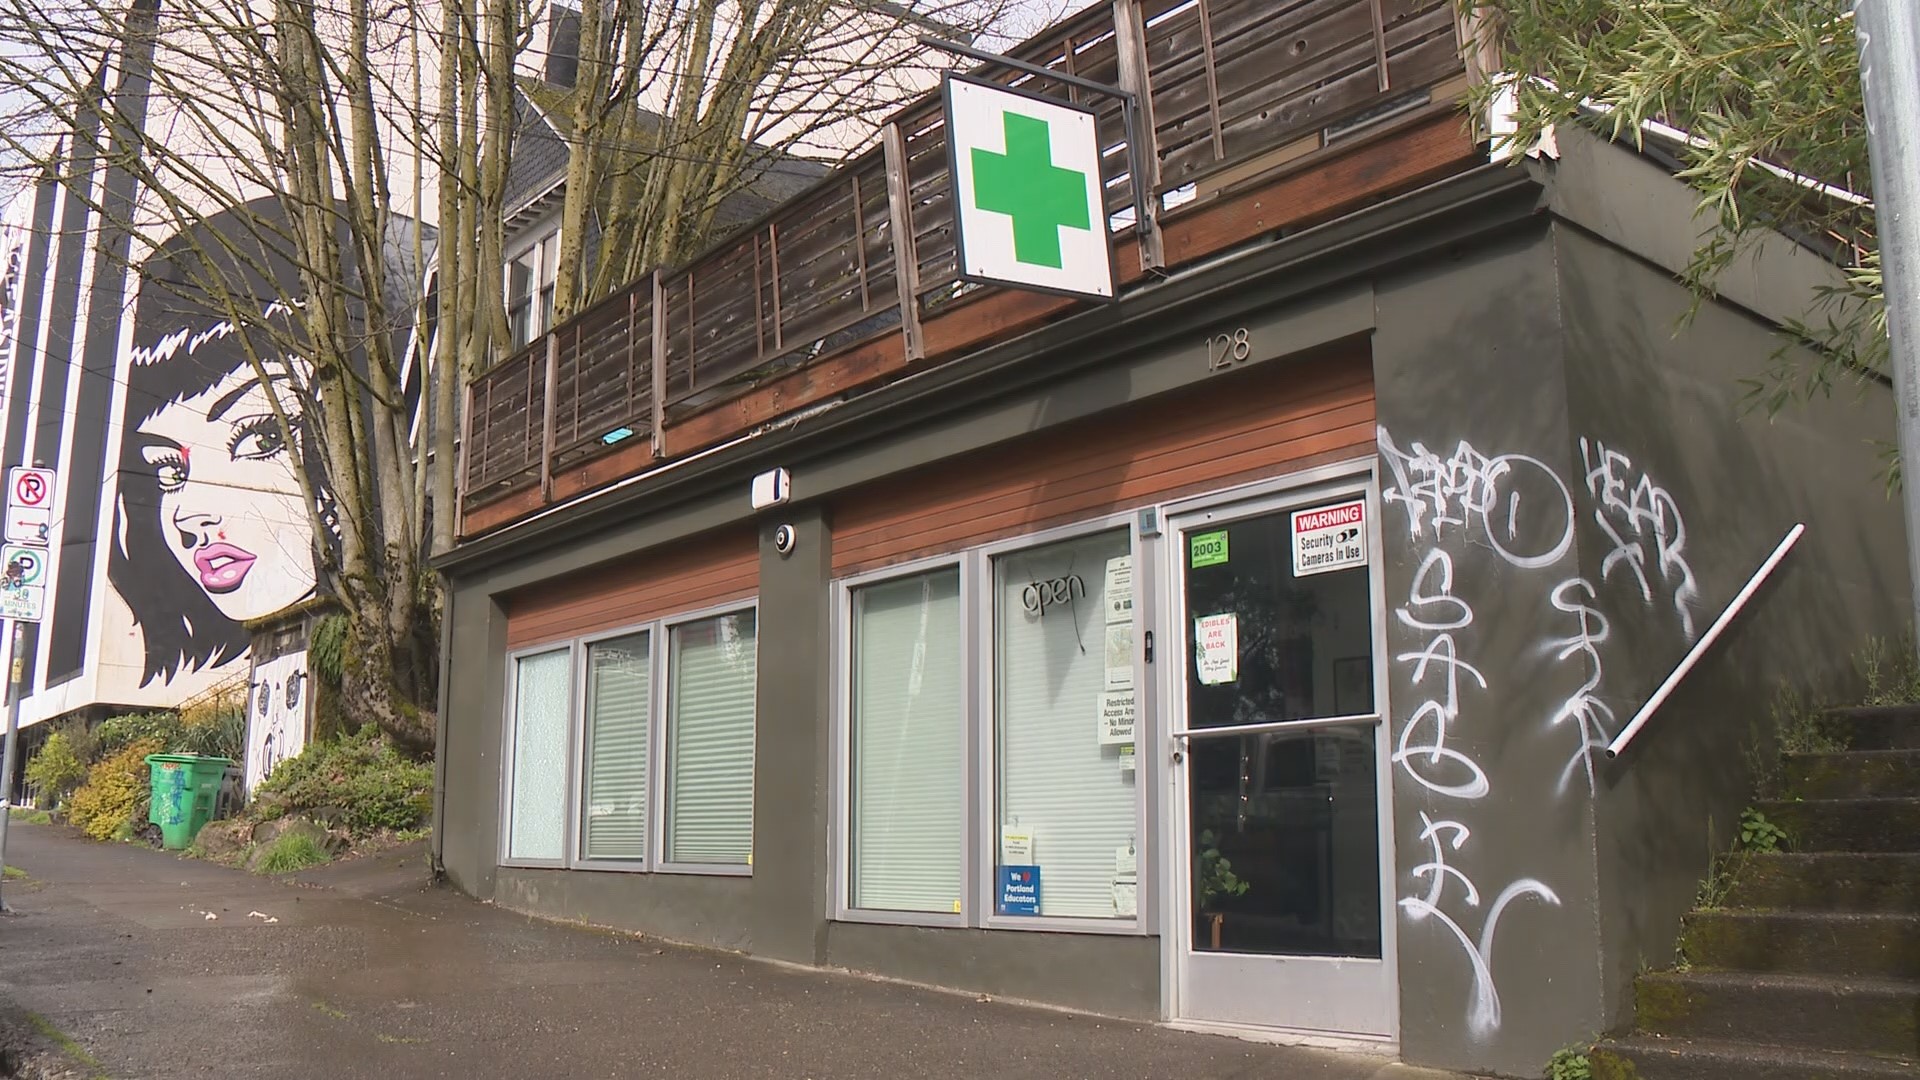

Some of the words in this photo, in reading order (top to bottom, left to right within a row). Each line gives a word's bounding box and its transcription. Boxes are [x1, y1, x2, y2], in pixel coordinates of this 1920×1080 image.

[1205, 327, 1250, 370] 128
[1298, 507, 1360, 531] WARNING
[1301, 534, 1334, 551] Security
[1193, 541, 1222, 557] 2003
[1302, 551, 1334, 567] Cameras
[1336, 547, 1344, 561] In
[1345, 546, 1360, 559] Use
[1022, 574, 1086, 616] open
[1201, 618, 1230, 628] EDIBLES
[1207, 630, 1223, 639] ARE
[1205, 641, 1226, 650] BACK
[1106, 697, 1135, 707] Restricted
[1103, 709, 1123, 717] Access
[1124, 707, 1135, 716] Are
[1109, 718, 1117, 727] No
[1117, 717, 1135, 726] Minor
[1109, 727, 1132, 737] Allowed
[1010, 872, 1022, 881] We
[1006, 884, 1034, 893] Portland
[1004, 893, 1036, 903] Educators
